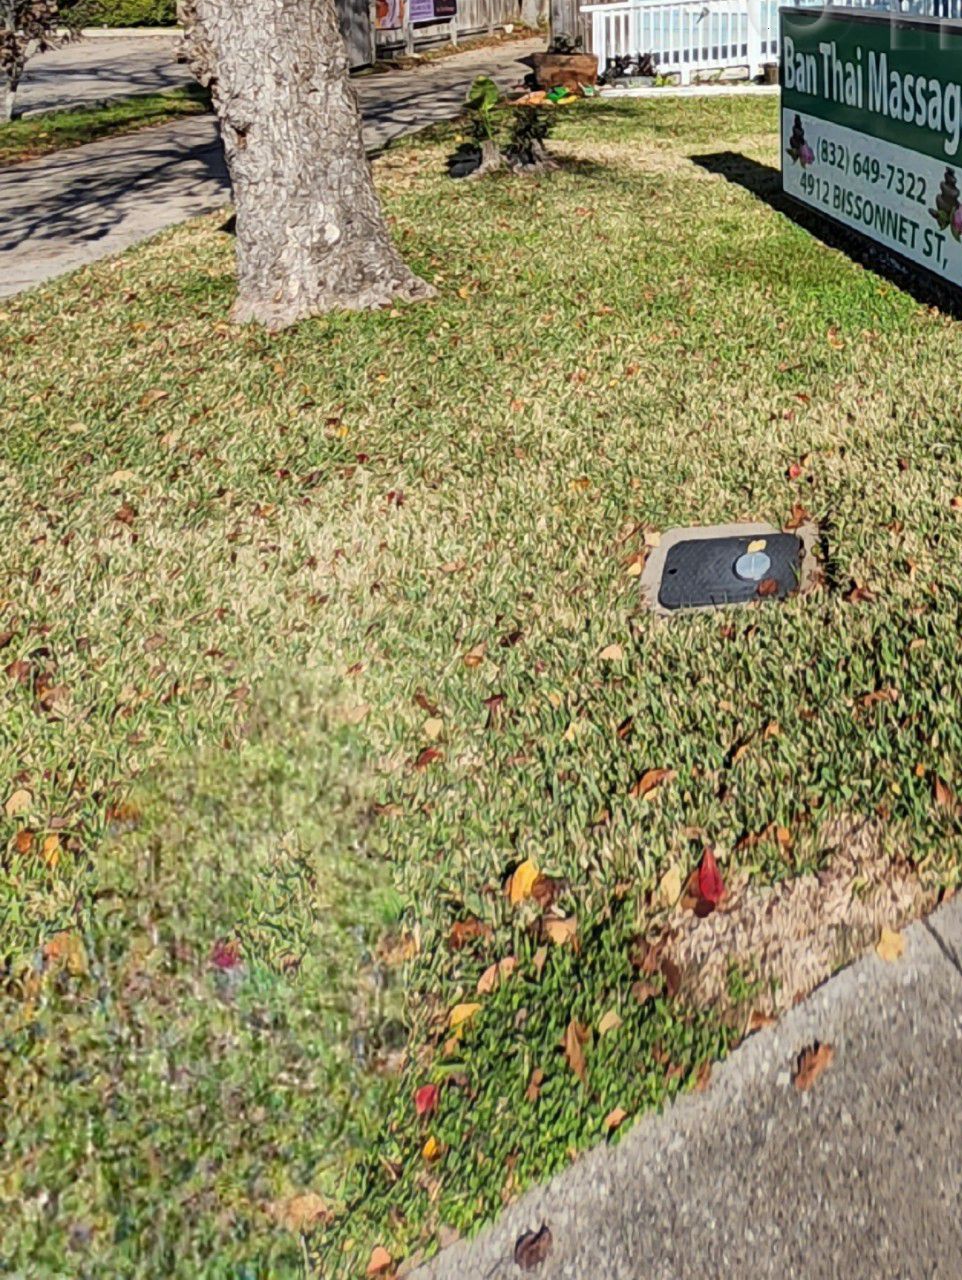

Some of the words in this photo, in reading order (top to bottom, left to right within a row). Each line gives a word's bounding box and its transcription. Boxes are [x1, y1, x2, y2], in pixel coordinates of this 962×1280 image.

[784, 36, 818, 96] Ban
[819, 41, 864, 110] Thai
[816, 136, 851, 177] (832)
[853, 153, 927, 206] 649-7322
[800, 171, 830, 205] 4912
[833, 185, 920, 250] BISSONNET
